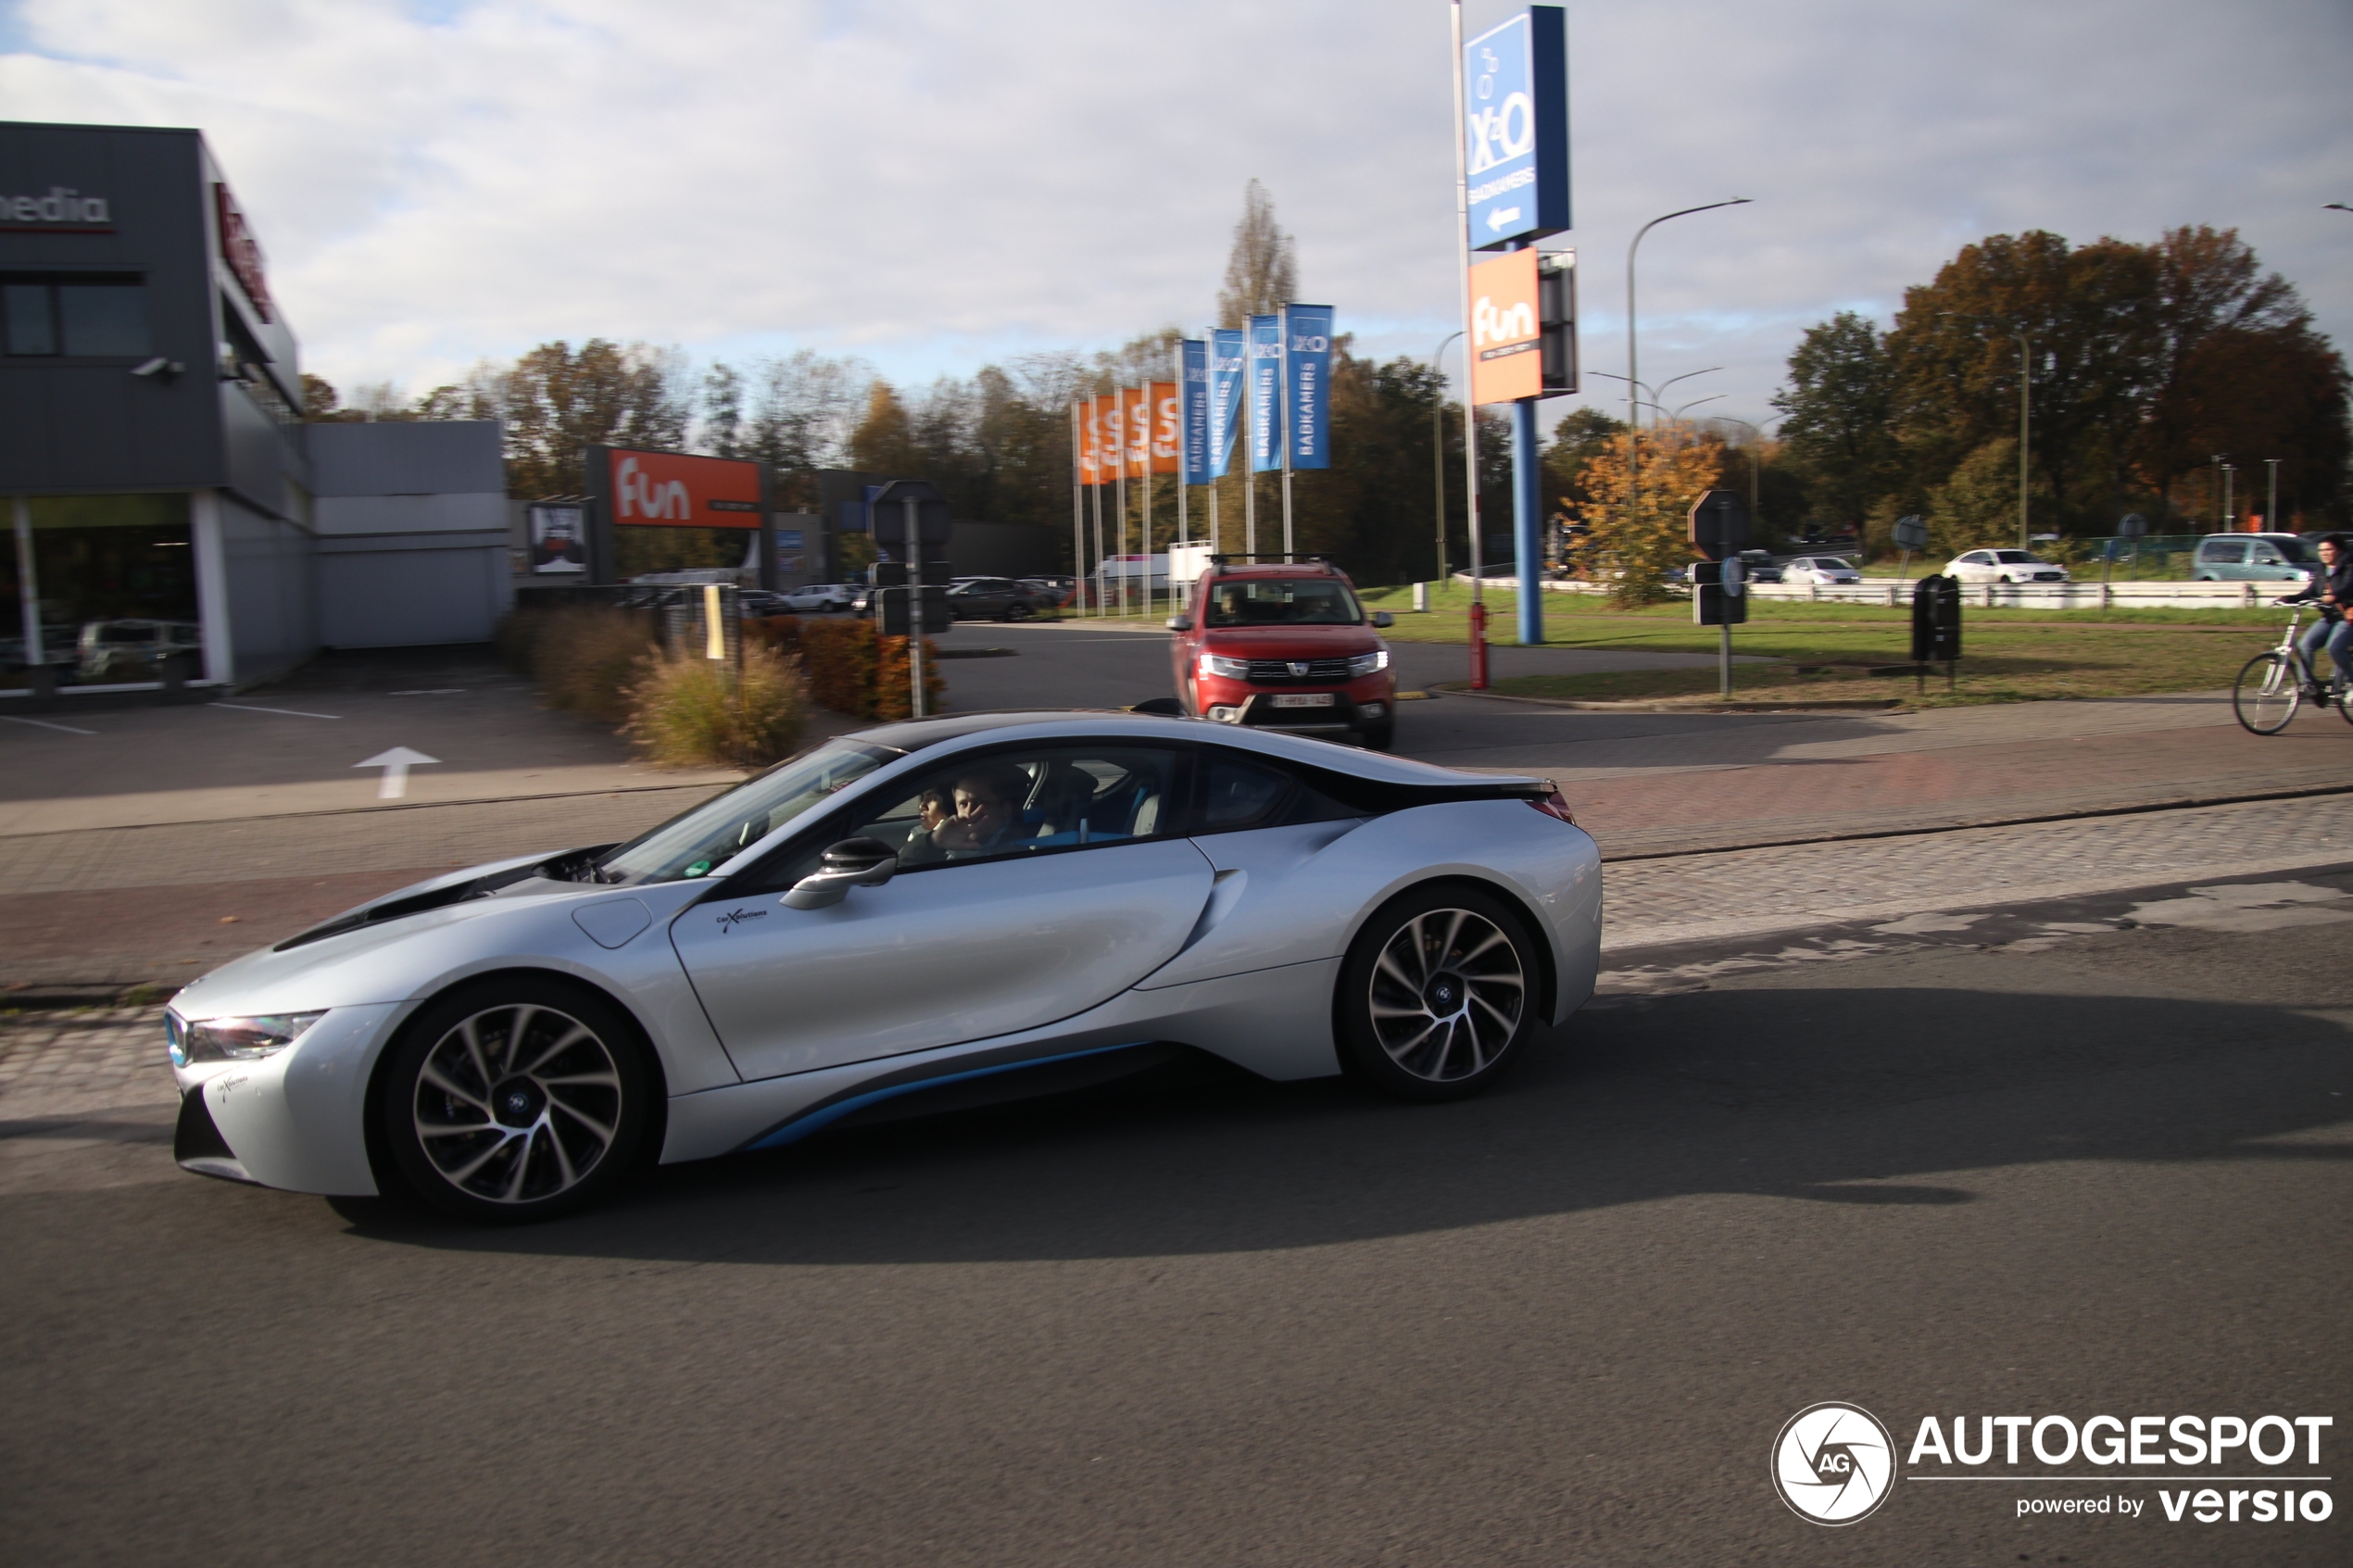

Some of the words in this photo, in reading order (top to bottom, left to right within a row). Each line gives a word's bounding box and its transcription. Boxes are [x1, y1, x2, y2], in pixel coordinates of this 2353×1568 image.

[1472, 296, 1534, 346] fun
[1256, 368, 1274, 458] BADKAMERS
[1298, 362, 1315, 456] BADKAMERS
[616, 457, 690, 521] fun
